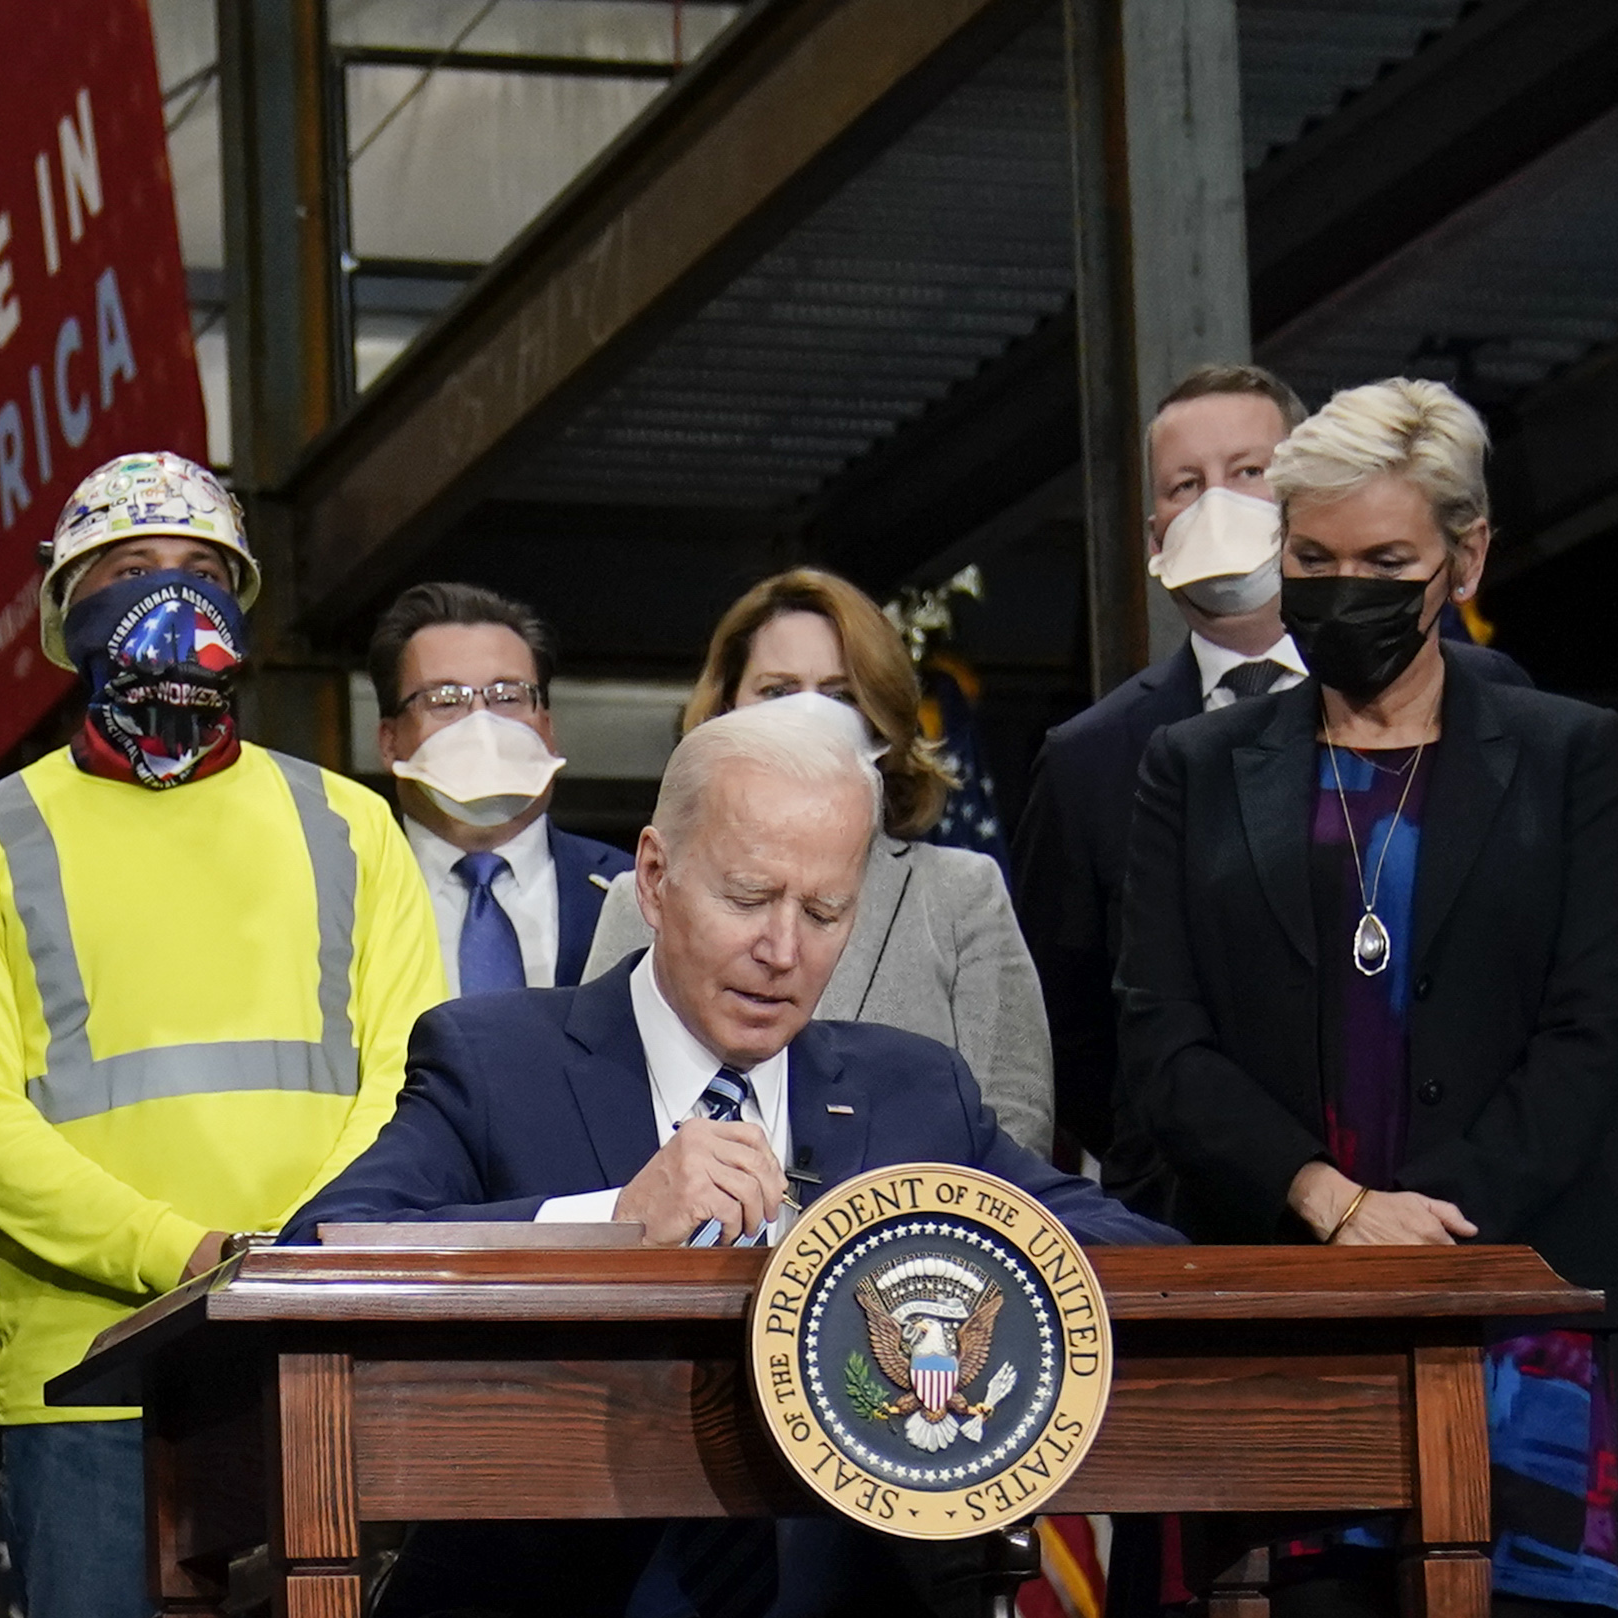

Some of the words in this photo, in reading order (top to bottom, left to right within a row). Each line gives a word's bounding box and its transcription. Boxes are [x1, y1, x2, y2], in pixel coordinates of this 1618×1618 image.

[34, 88, 104, 276] IN
[108, 585, 178, 659] NTERNATIONAL
[935, 1182, 969, 1206] OF
[976, 1190, 1020, 1229] THE
[765, 1178, 924, 1338] PRESIDENT
[1026, 1224, 1100, 1378] UNITED
[769, 1352, 797, 1404] THE
[783, 1411, 811, 1443] OF
[810, 1442, 900, 1520] SEAL
[964, 1411, 1084, 1522] STATES
